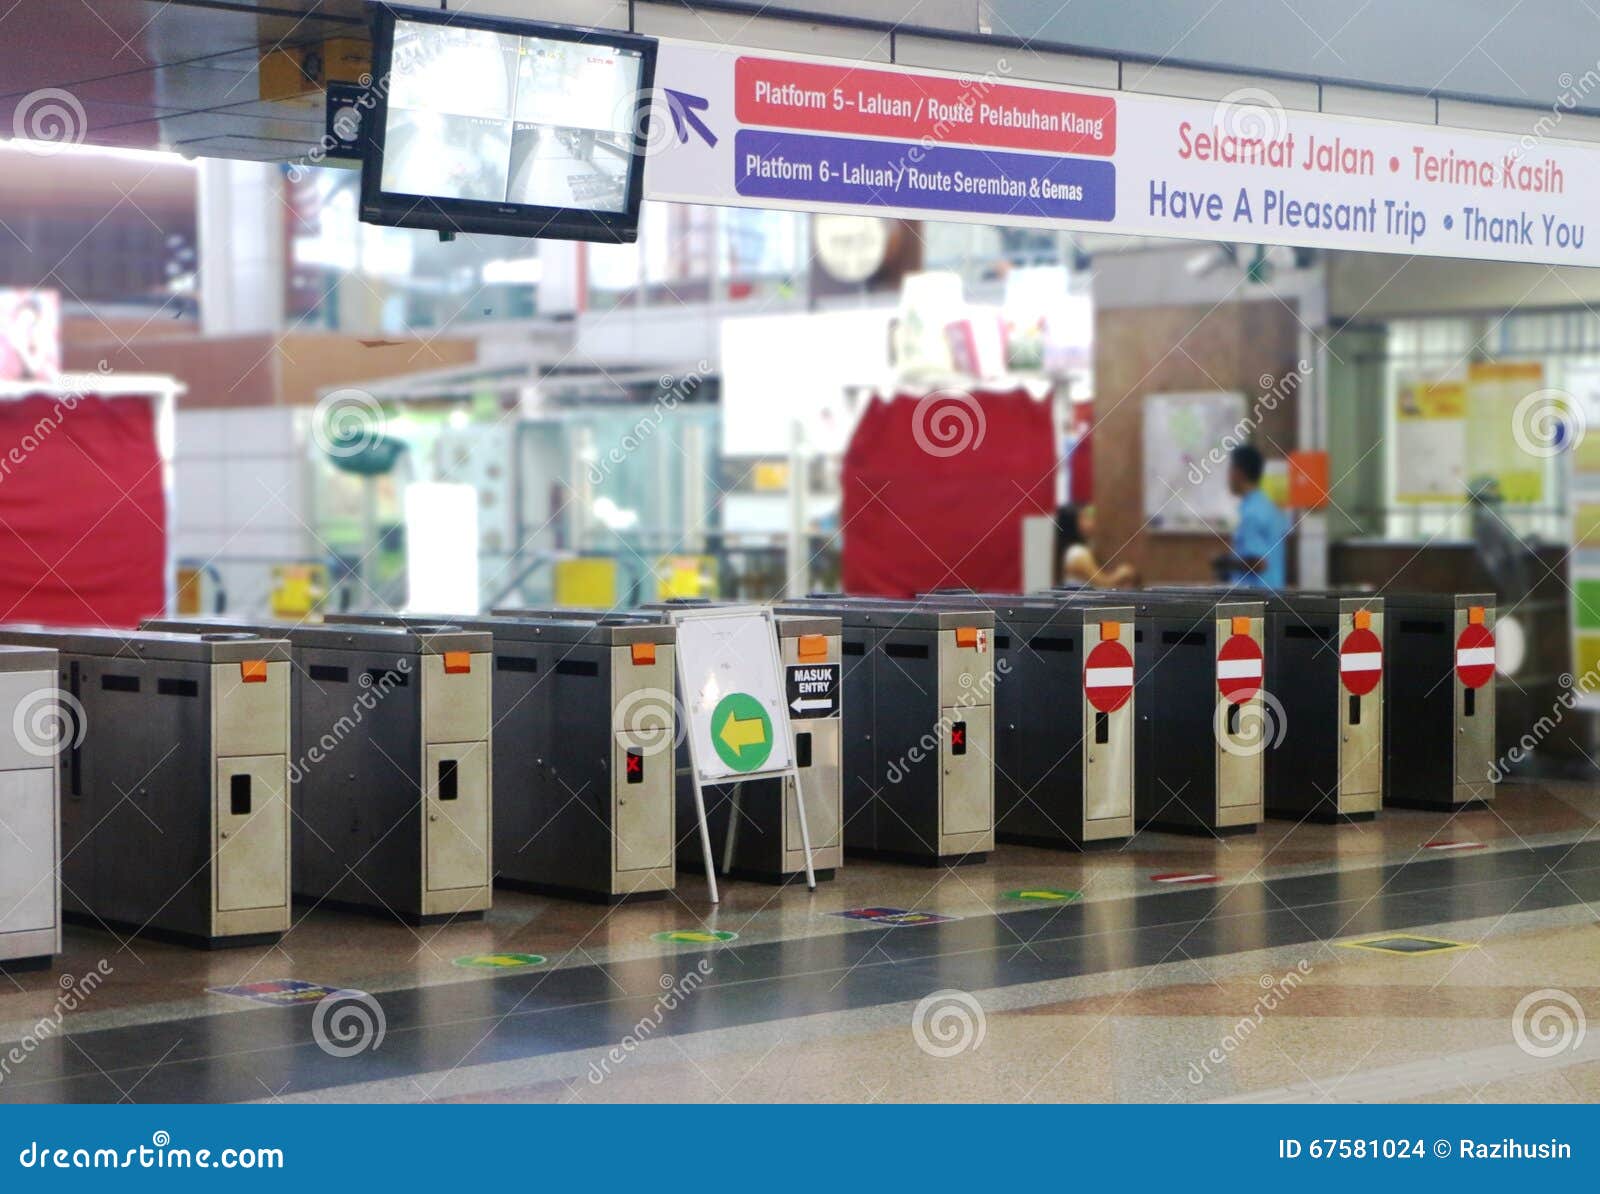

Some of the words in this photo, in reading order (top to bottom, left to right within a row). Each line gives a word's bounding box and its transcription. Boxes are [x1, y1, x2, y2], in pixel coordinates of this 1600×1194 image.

[755, 80, 827, 109] Platform
[858, 91, 912, 117] Laluan
[928, 97, 974, 123] Route
[979, 103, 1059, 132] Pelabuhan
[1061, 111, 1104, 141] Klang
[746, 153, 813, 181] Platform
[842, 162, 894, 187] Laluan
[907, 167, 952, 192] Route
[953, 170, 1027, 198] Seremban
[1041, 178, 1084, 202] Gemas
[1178, 121, 1295, 169] Selamat
[1302, 135, 1375, 176] Jalan
[1413, 146, 1494, 188] Terima
[1502, 155, 1565, 194] Kasih
[1148, 179, 1224, 221] Have
[1233, 189, 1254, 223] A
[1263, 189, 1377, 234] Pleasant
[1384, 199, 1427, 245] Trip
[1463, 206, 1534, 246] Thank
[1544, 213, 1585, 250] You
[794, 668, 832, 682] MASUK
[799, 681, 830, 693] ENTRY
